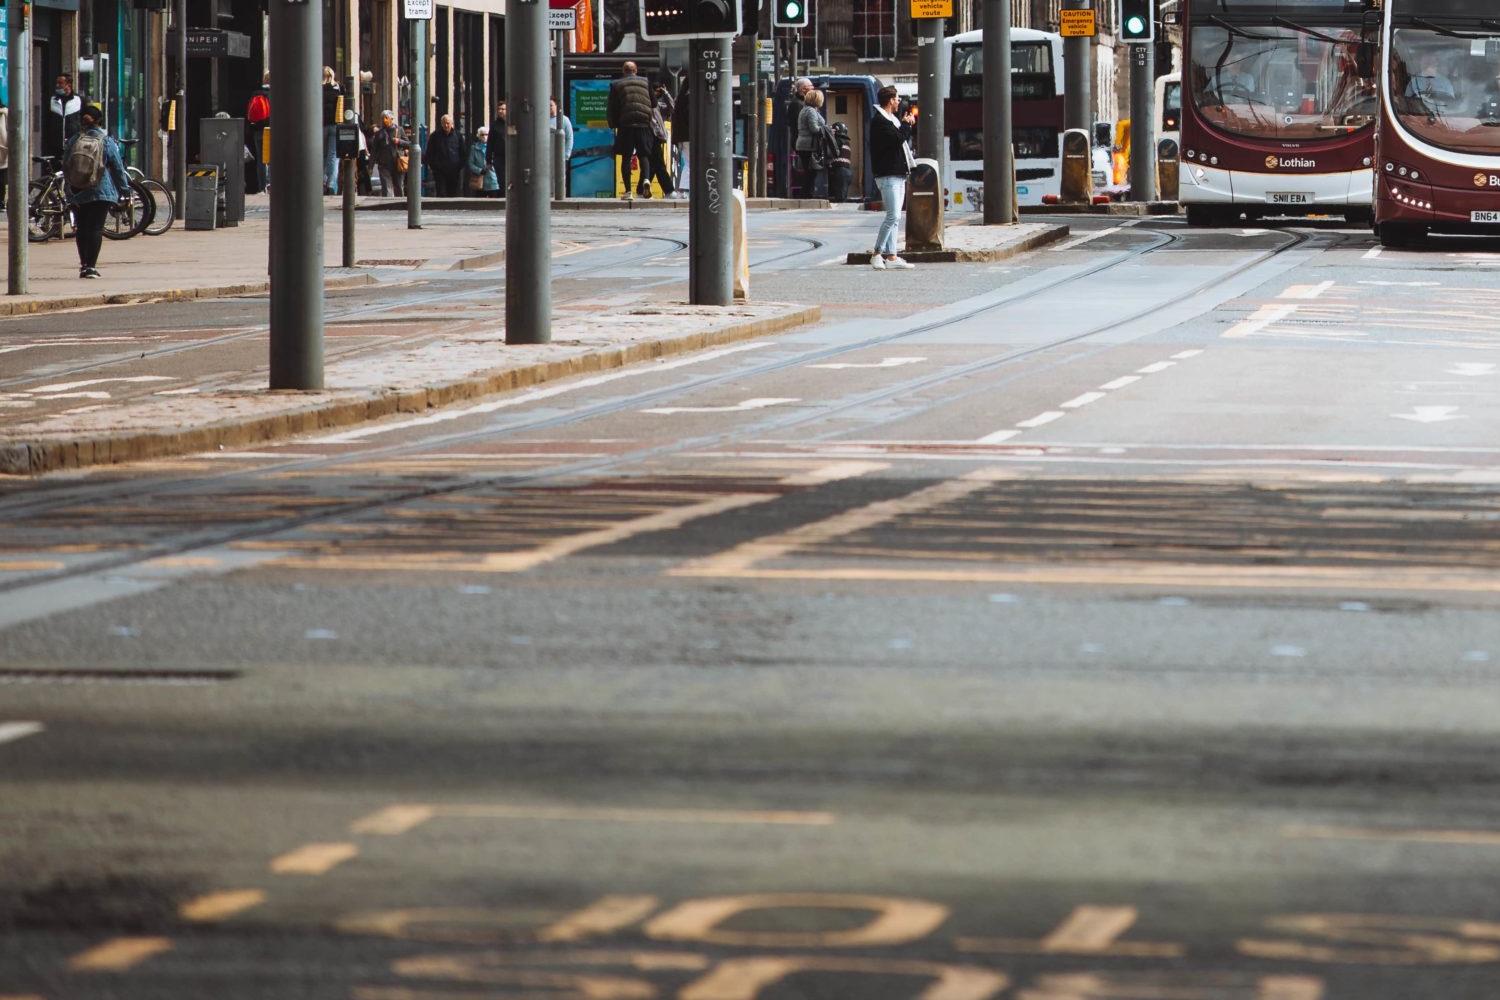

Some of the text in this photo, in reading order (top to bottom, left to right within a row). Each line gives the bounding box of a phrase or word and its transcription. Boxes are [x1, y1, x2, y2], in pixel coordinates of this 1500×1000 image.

[408, 7, 428, 16] trams
[1062, 17, 1093, 25] Emergency
[186, 36, 218, 44] NIPER
[703, 50, 720, 59] CTY
[707, 60, 716, 69] 13
[705, 71, 718, 80] 08
[1279, 157, 1316, 168] Lothian
[1290, 194, 1307, 203] EBA
[1474, 212, 1498, 222] BN64
